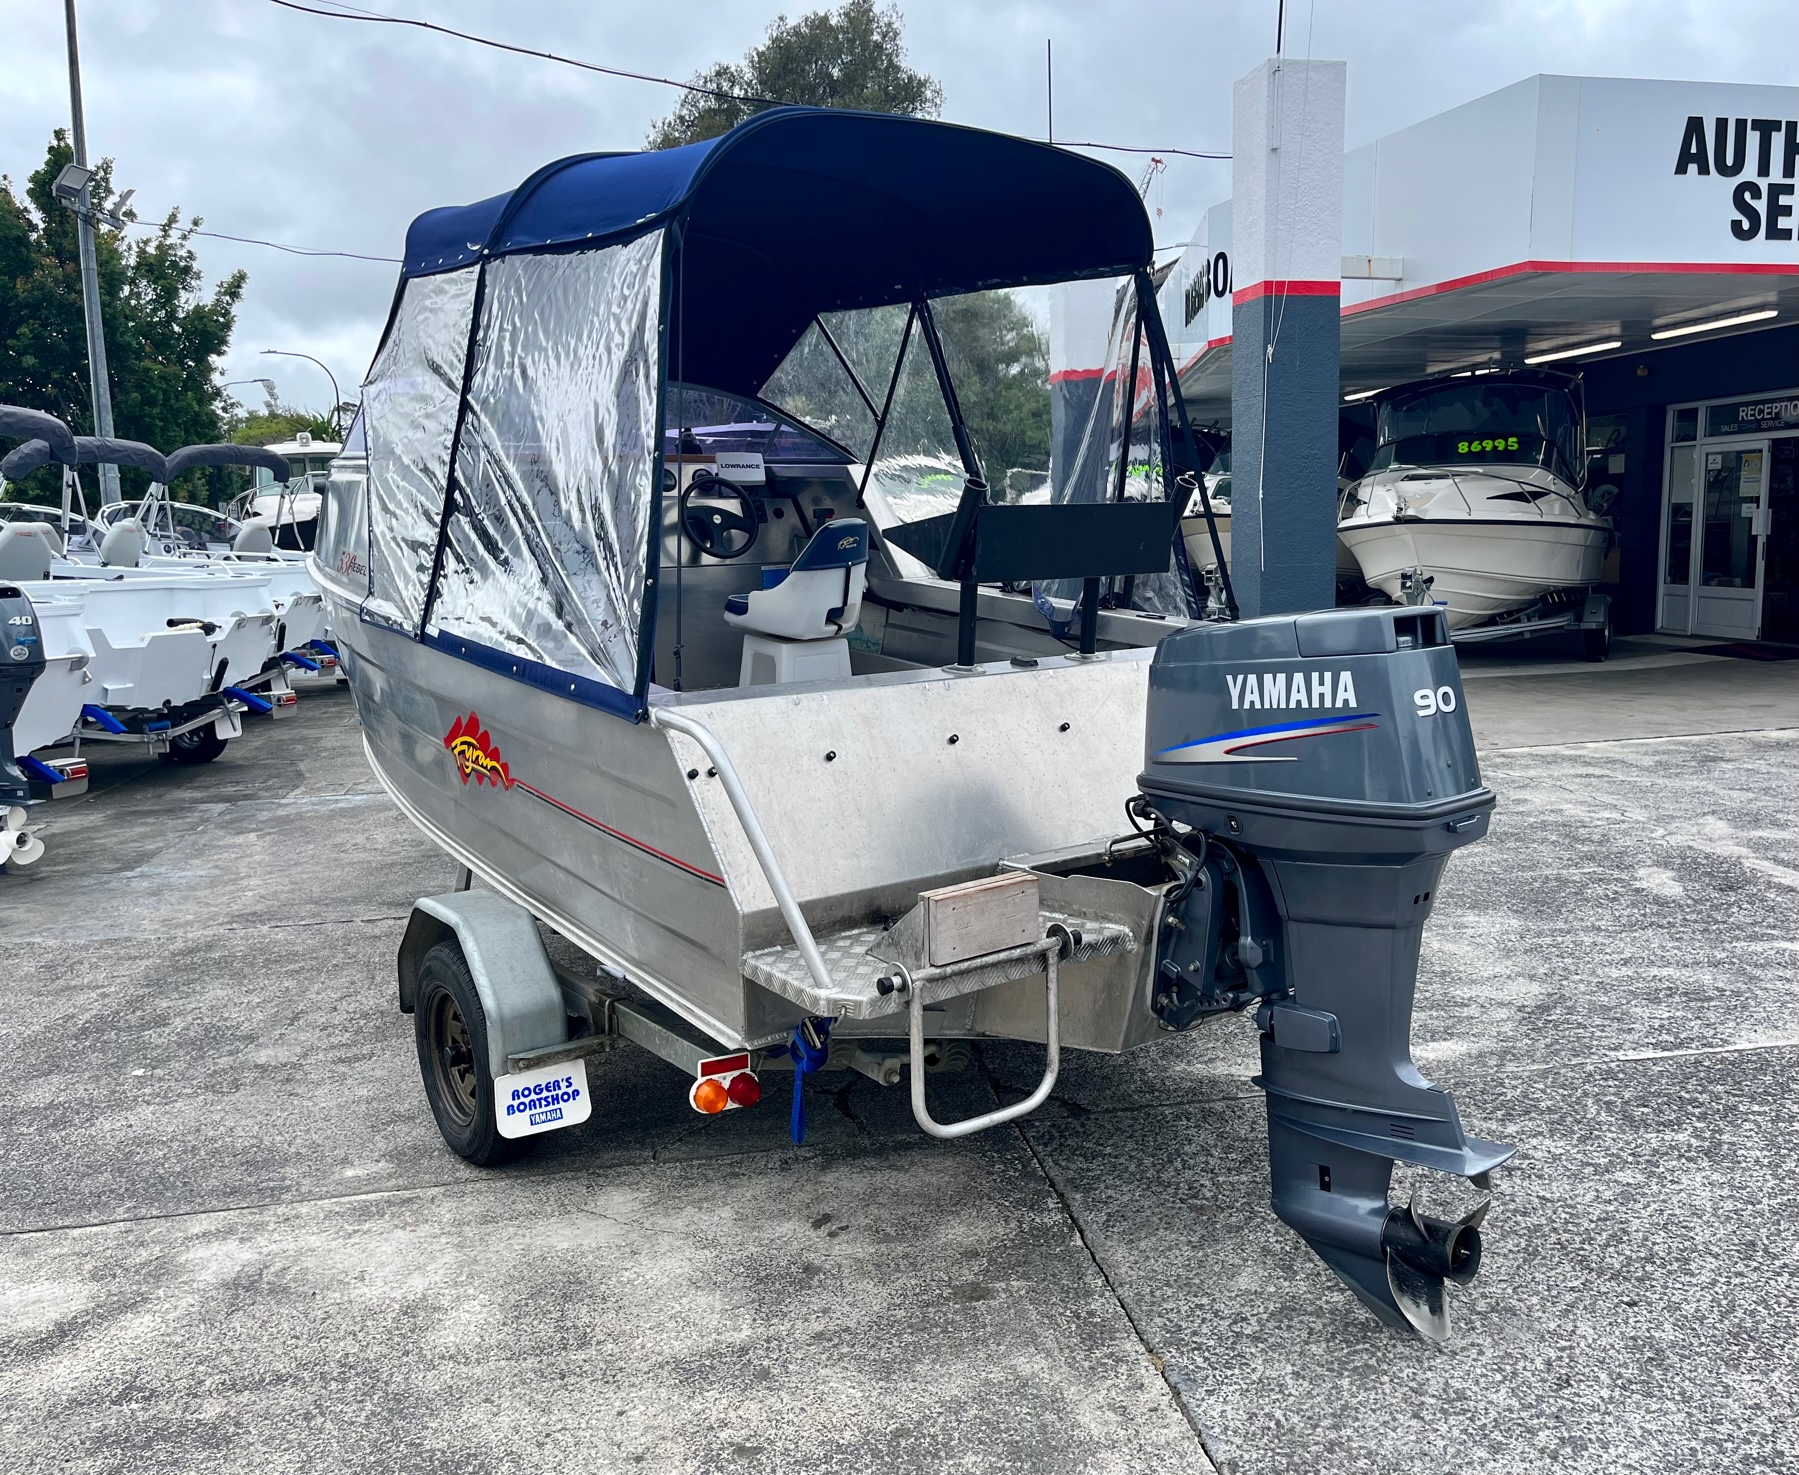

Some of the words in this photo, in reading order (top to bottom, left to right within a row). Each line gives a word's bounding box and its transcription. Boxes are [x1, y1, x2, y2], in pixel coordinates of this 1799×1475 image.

[1674, 116, 1799, 179] AUTH
[1730, 180, 1799, 241] SE
[1720, 424, 1738, 432] SALES
[1760, 418, 1785, 428] SERVICE
[1457, 437, 1519, 453] 86995
[8, 616, 33, 625] 40
[1226, 671, 1358, 710] YAMAHA
[1413, 686, 1456, 717] 90
[511, 1076, 573, 1101] ROGER'S
[506, 1089, 580, 1116] BOATSHOP
[530, 1108, 562, 1125] YAMAHA
